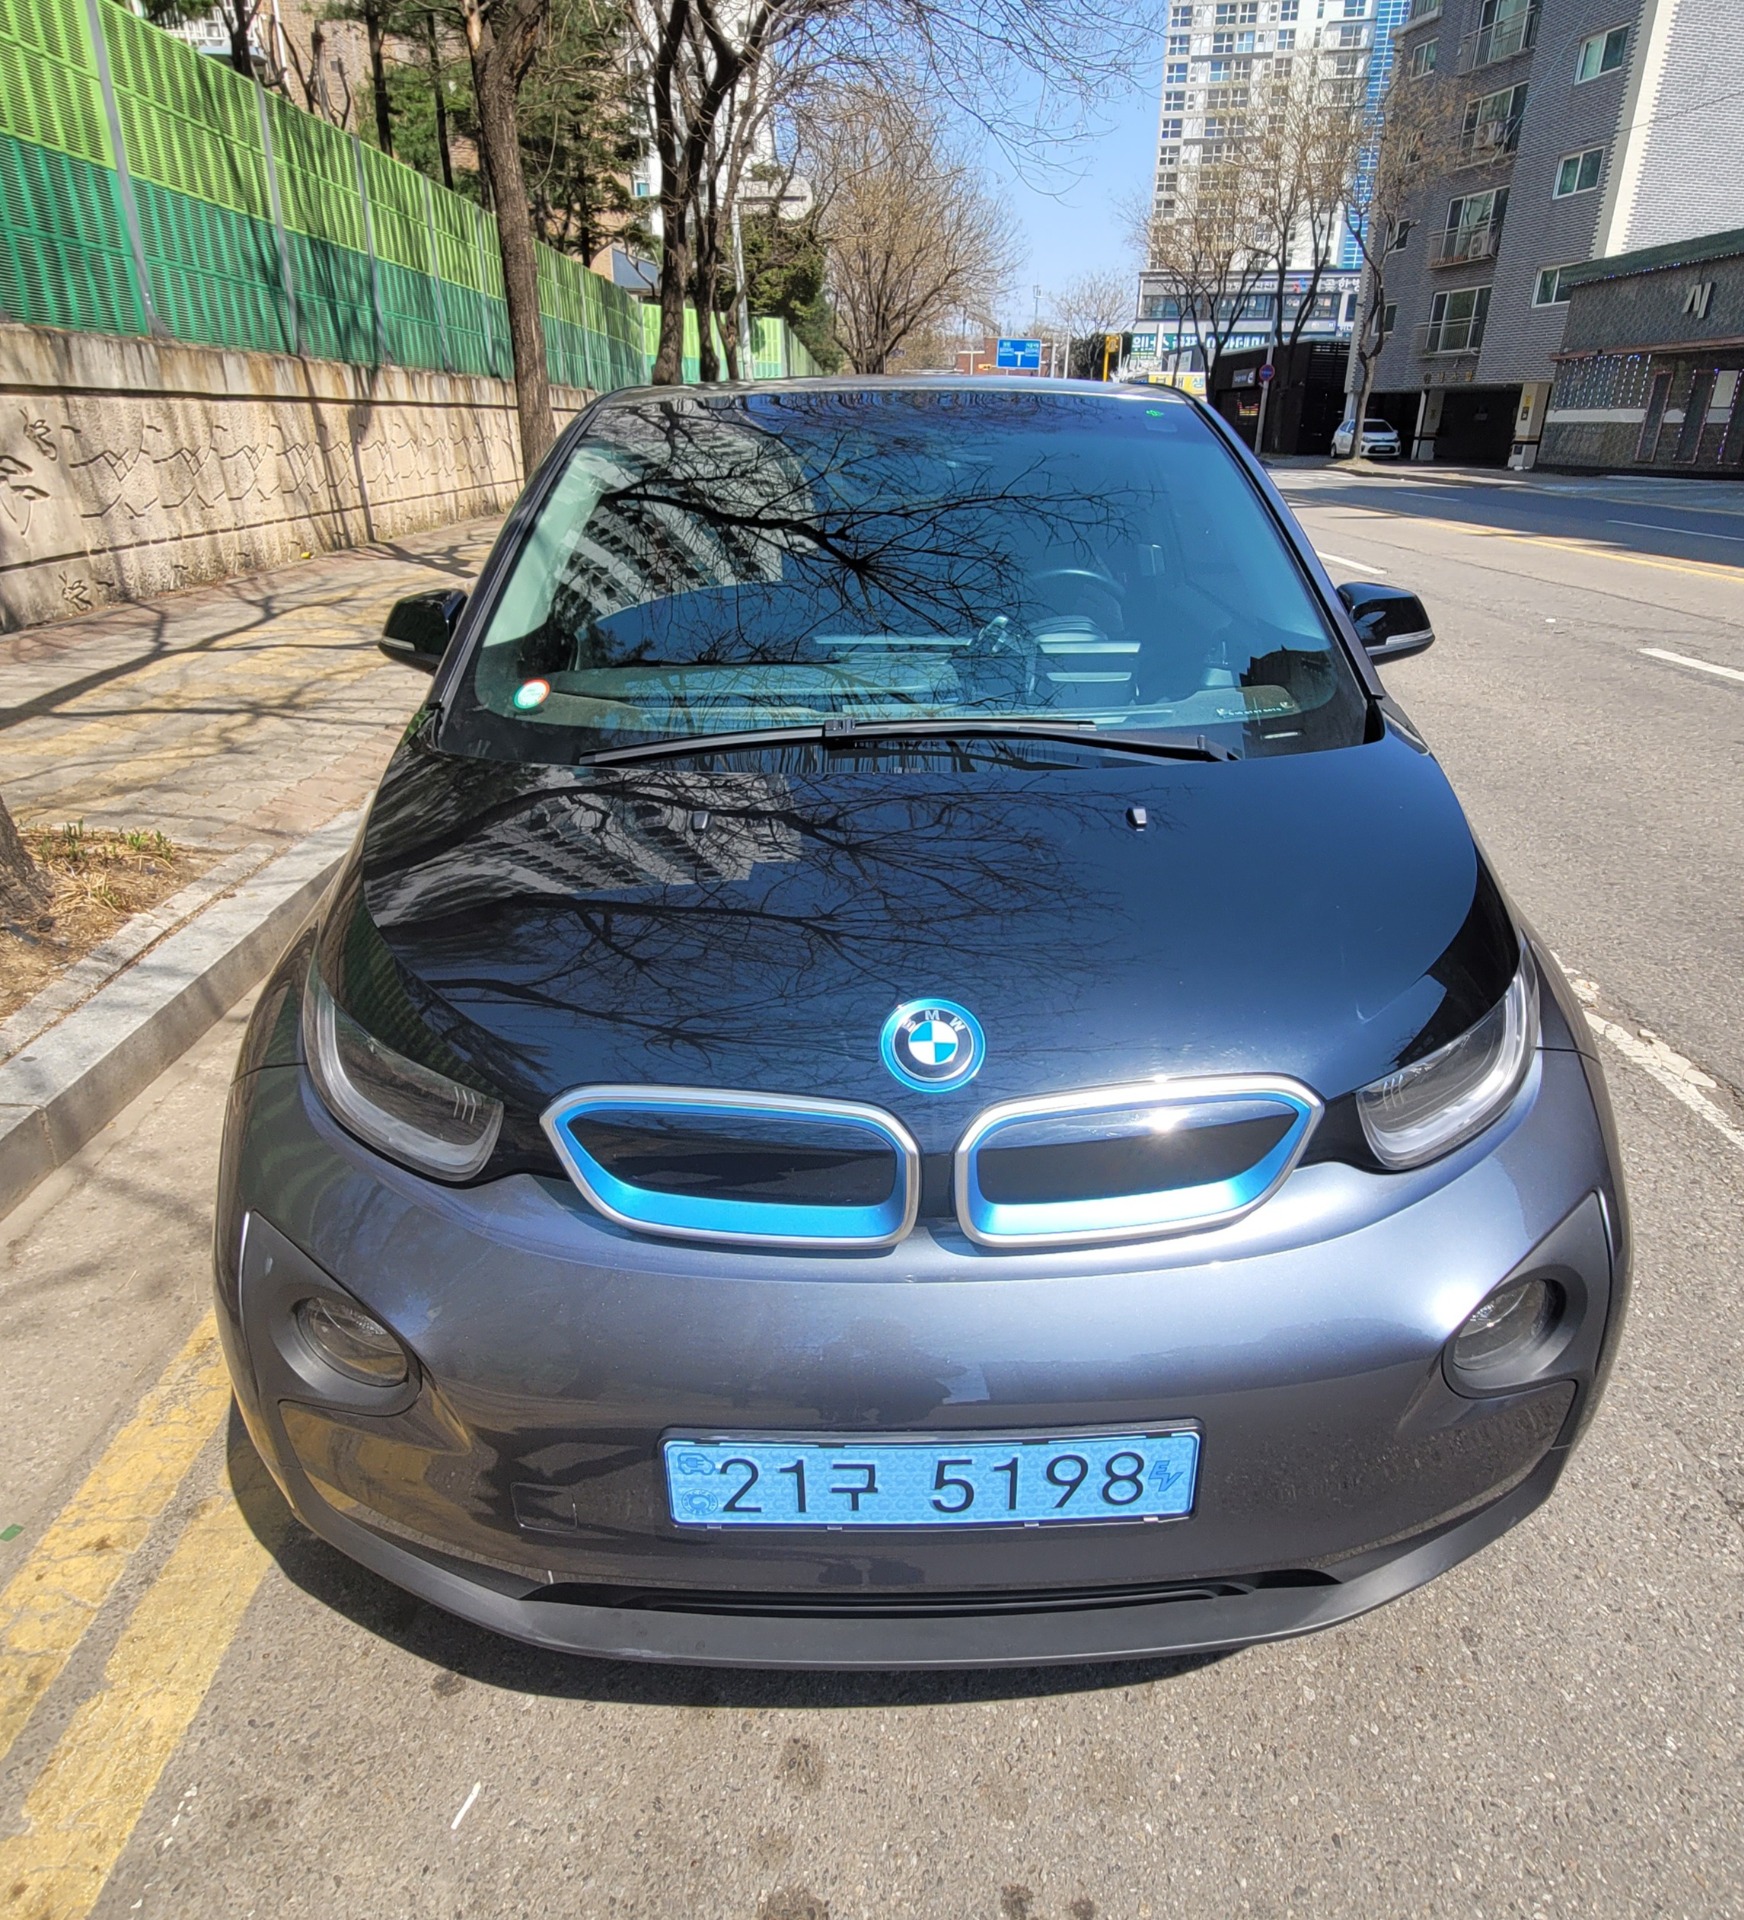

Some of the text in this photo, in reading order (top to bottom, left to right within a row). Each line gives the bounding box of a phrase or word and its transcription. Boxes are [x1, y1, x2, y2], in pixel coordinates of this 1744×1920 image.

[902, 1009, 967, 1033] BMW
[718, 1457, 879, 1513] 21구
[930, 1451, 1145, 1513] 5198
[1148, 1460, 1185, 1492] EV
